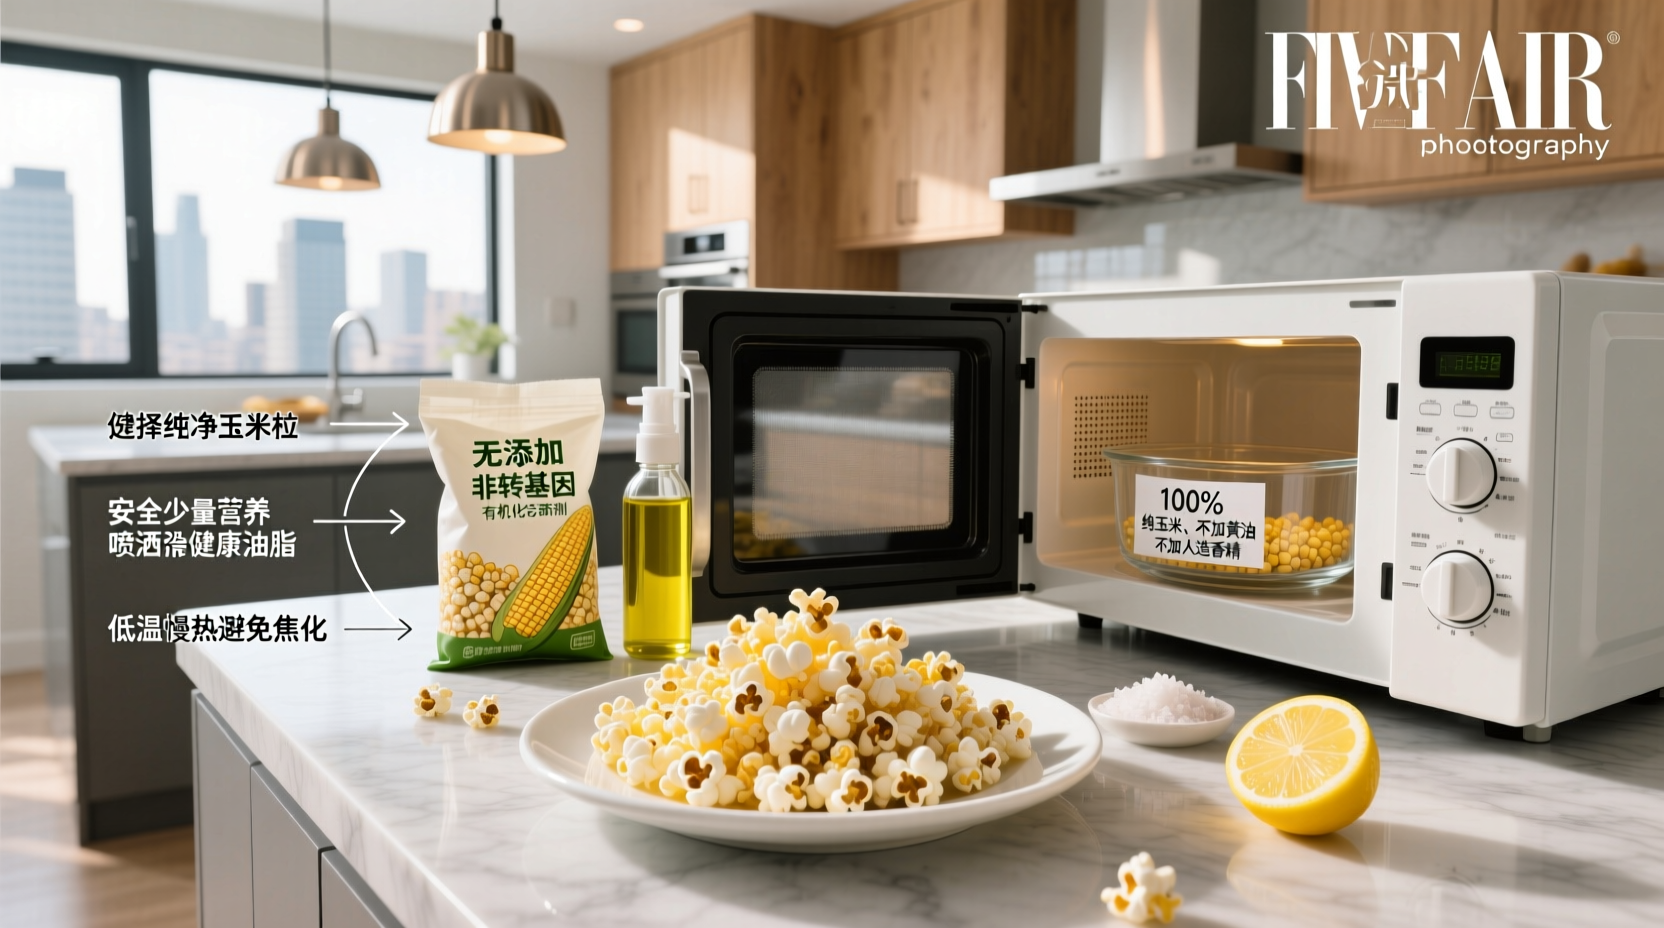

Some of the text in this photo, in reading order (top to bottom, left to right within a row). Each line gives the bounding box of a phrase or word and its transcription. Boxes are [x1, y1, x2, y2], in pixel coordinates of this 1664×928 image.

[472, 437, 564, 468] 无添加
[471, 470, 576, 500] 非转基因
[1160, 487, 1224, 515] 100%
